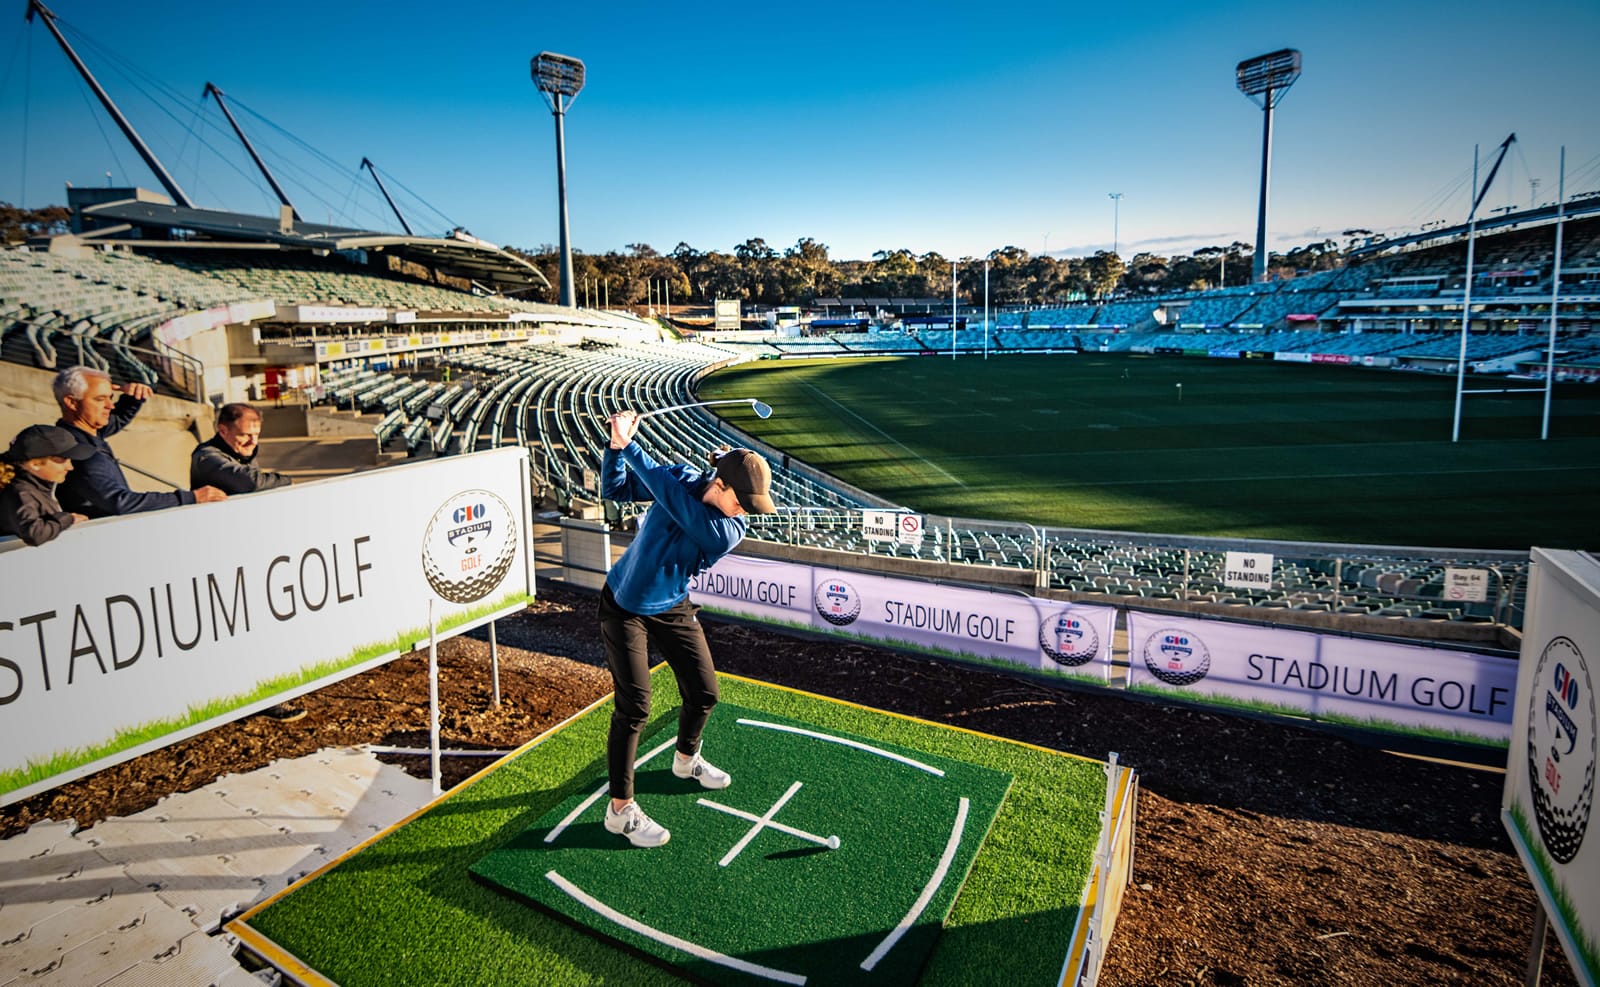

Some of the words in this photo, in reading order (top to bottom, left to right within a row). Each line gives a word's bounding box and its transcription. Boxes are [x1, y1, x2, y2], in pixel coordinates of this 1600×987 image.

[453, 504, 485, 523] GIO
[875, 516, 884, 525] NO
[448, 521, 492, 540] STADIUM
[864, 526, 894, 537] STANDING
[461, 554, 481, 571] GOLF
[1243, 558, 1256, 568] NO
[266, 536, 372, 622] GOLF
[1227, 571, 1270, 583] STANDING
[757, 581, 796, 607] GOLF
[829, 584, 846, 593] GIO
[885, 600, 961, 635] STADIUM
[967, 614, 1015, 643] GOLF
[1059, 619, 1080, 629] GIO
[1165, 635, 1188, 645] GIO
[1247, 653, 1398, 702] STADIUM
[1411, 677, 1509, 716] GOLF
[1554, 662, 1579, 710] GIO
